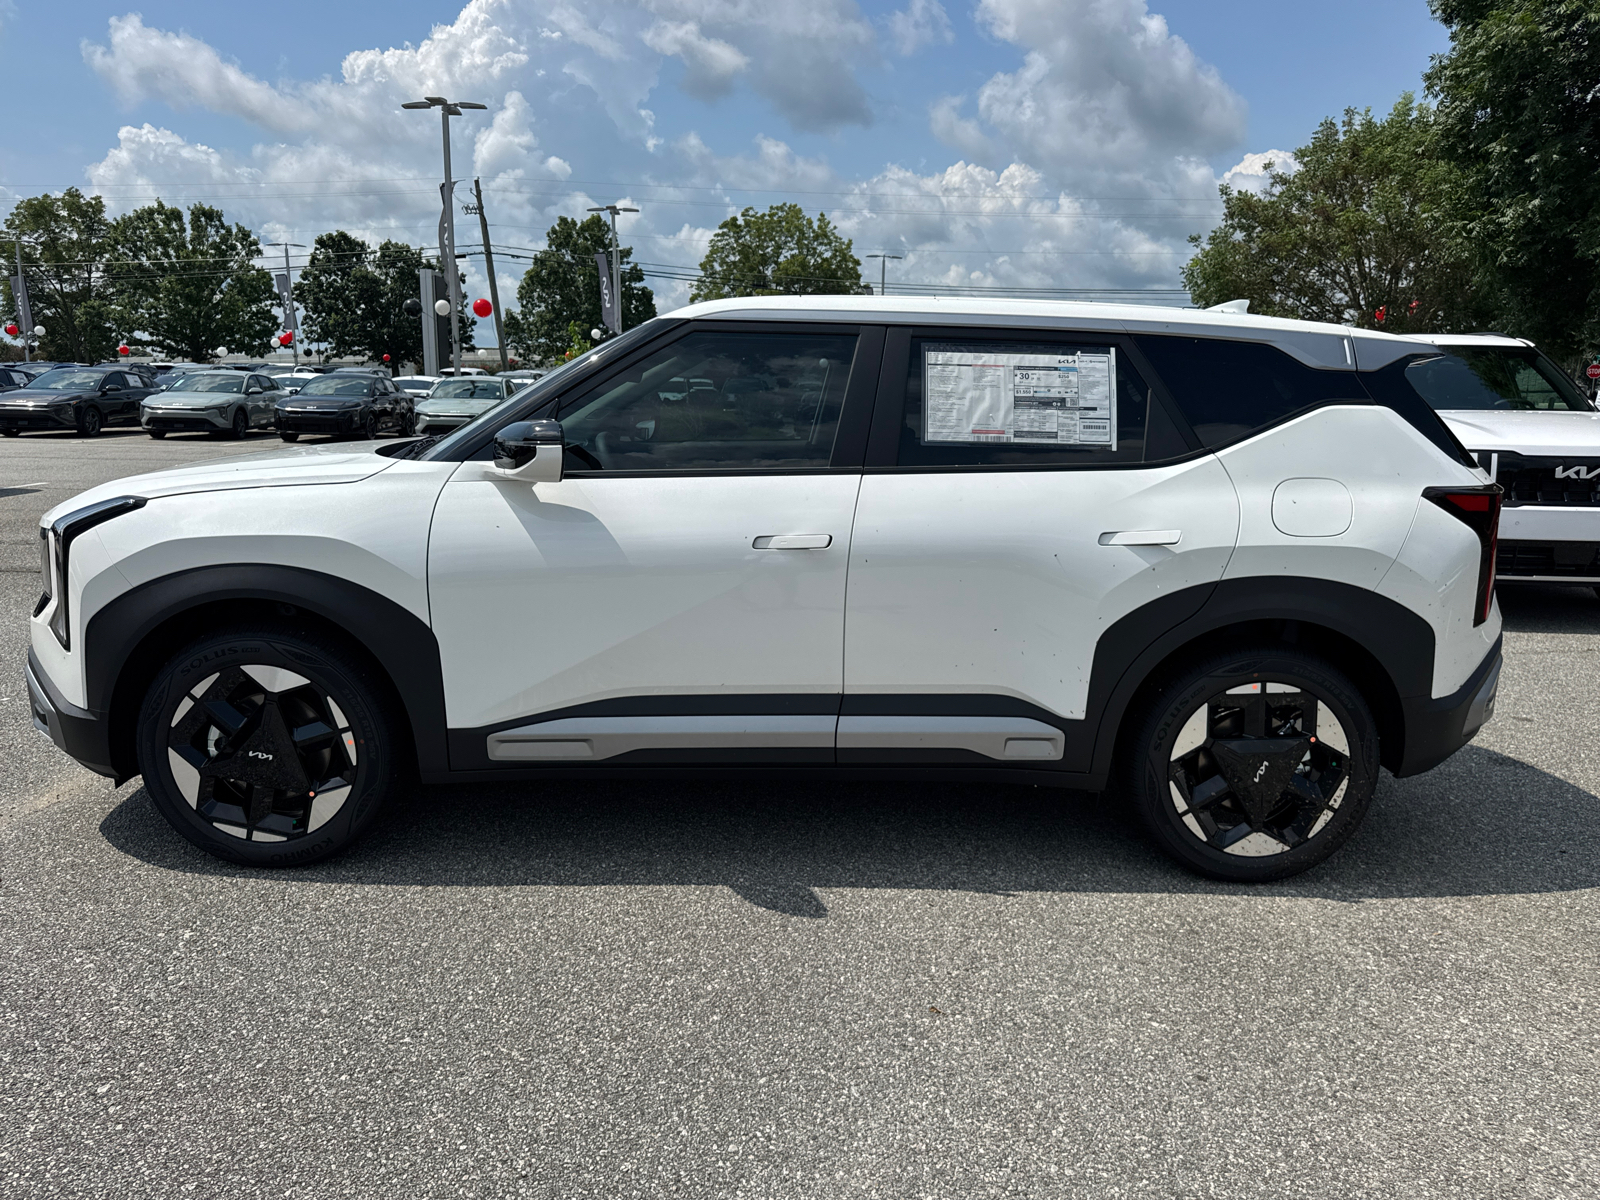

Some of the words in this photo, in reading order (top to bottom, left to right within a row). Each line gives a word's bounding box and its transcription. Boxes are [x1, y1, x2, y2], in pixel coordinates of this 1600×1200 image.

[1019, 372, 1030, 380] 30
[181, 646, 239, 676] SOLUS
[1153, 697, 1190, 752] SOLUS
[270, 836, 335, 862] KUMHO
